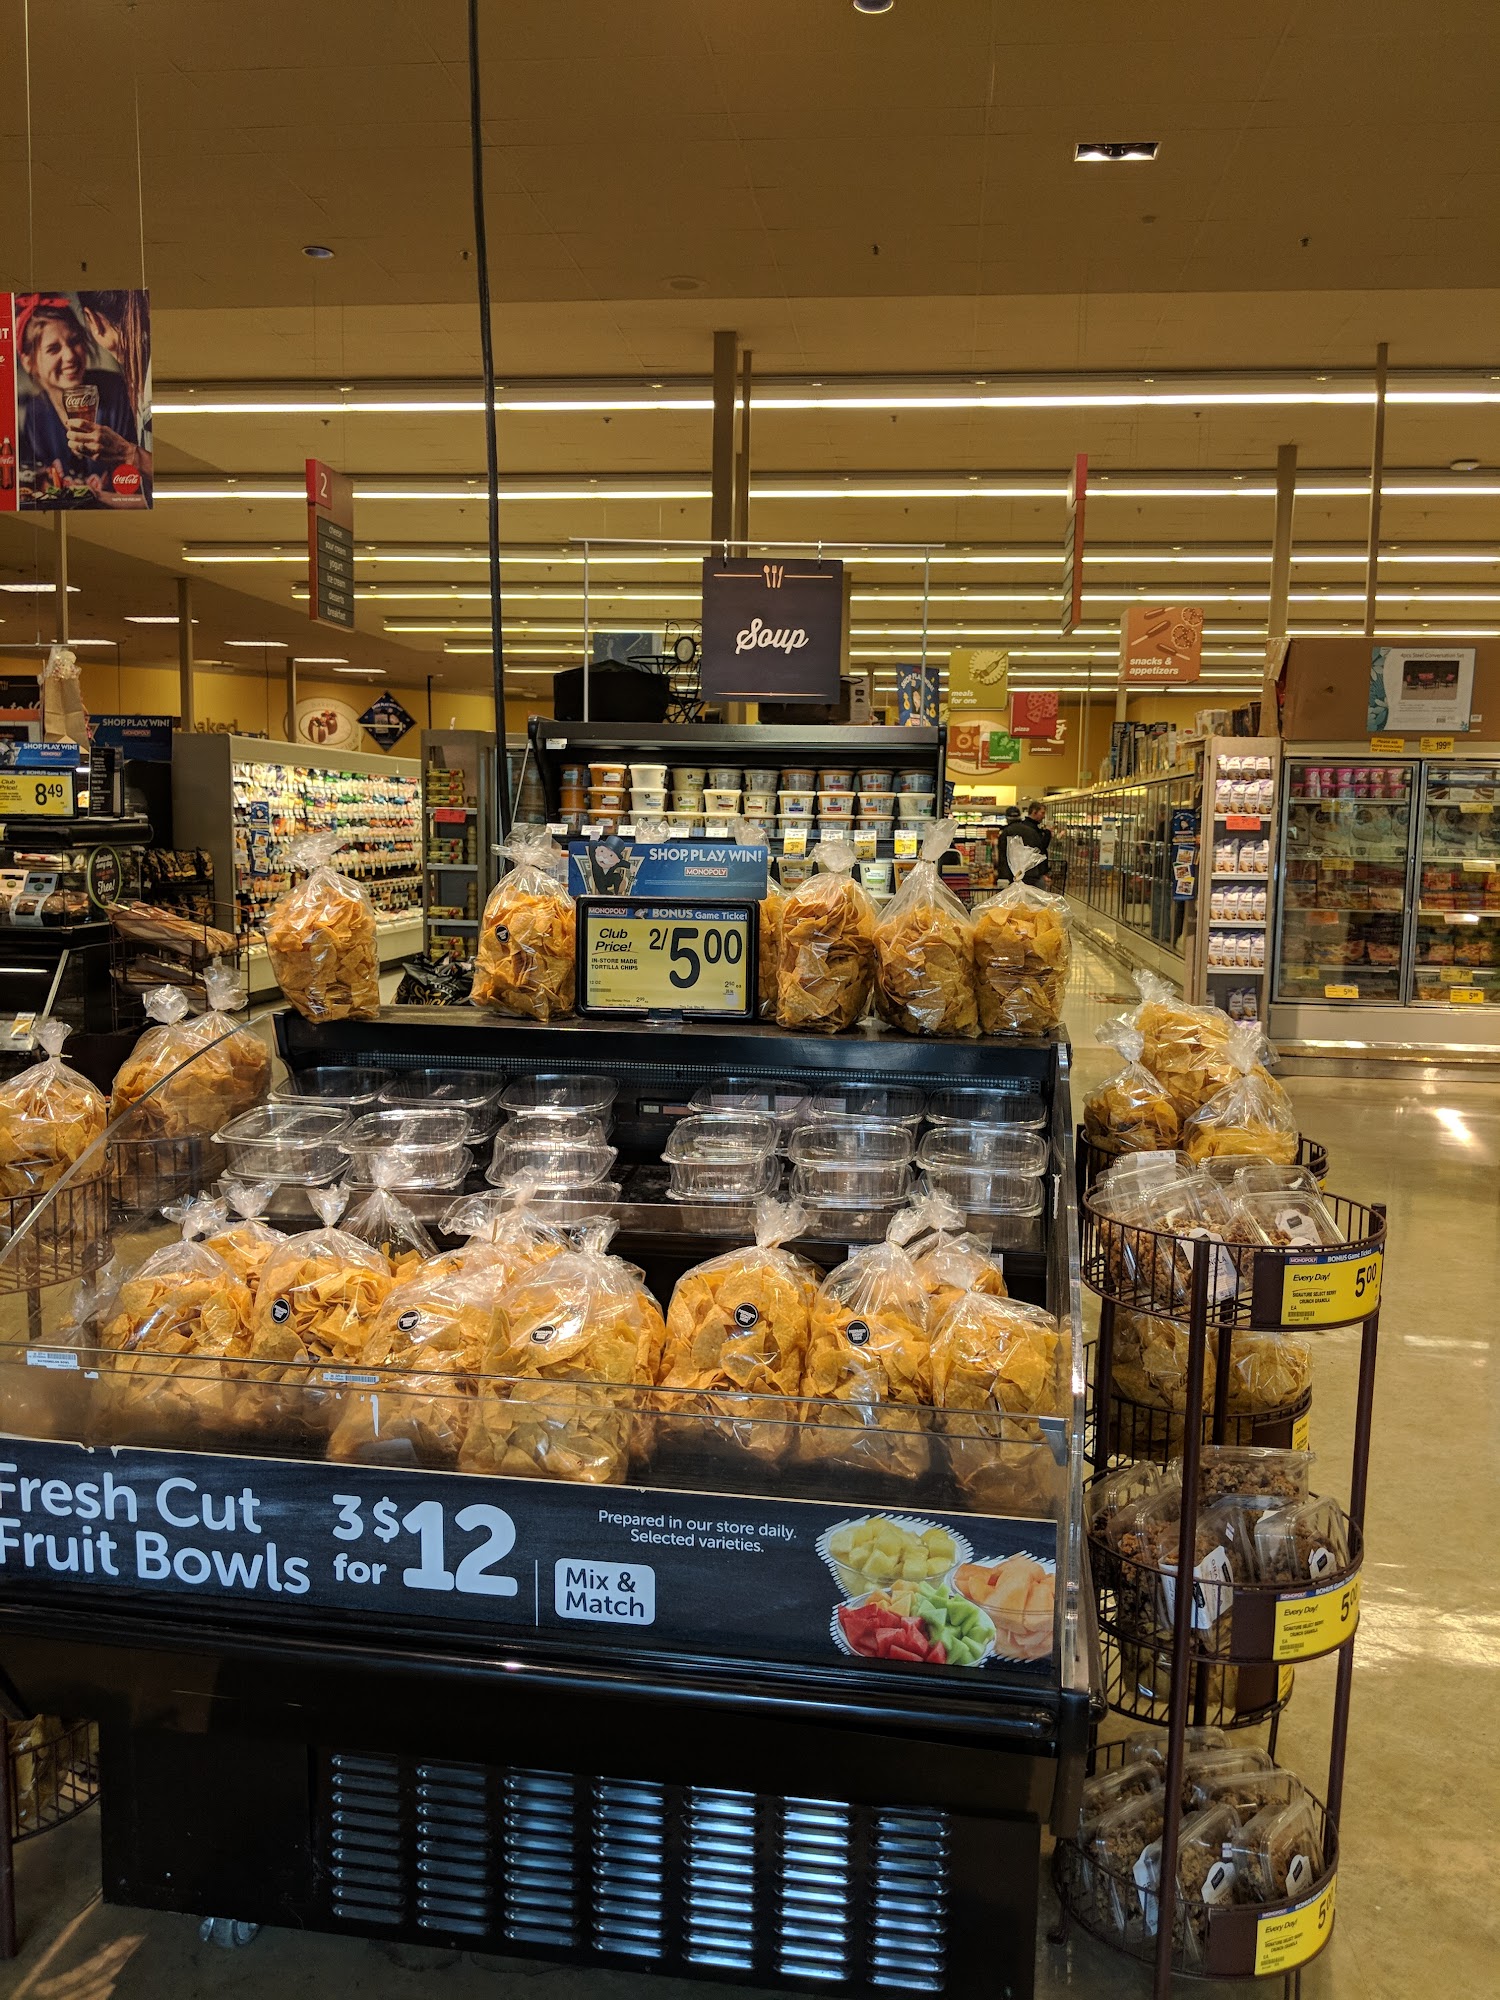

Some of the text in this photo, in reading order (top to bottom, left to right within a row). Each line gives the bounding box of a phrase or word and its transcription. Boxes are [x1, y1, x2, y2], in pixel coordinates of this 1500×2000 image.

[320, 472, 328, 498] 2
[328, 526, 342, 539] cheese
[325, 541, 346, 556] sour cream
[329, 559, 343, 572] yogurt
[334, 577, 346, 588] cream
[328, 592, 345, 605] desserts
[327, 606, 346, 620] breakfast
[735, 618, 809, 655] Soup
[1130, 657, 1172, 665] snacks &
[1129, 666, 1179, 676] appetizers
[150, 719, 170, 727] WIN!
[727, 849, 762, 863] WIN!
[684, 867, 728, 877] MONOPOLY
[588, 907, 628, 916] MONOPOLY
[652, 908, 748, 920] BONUS Game Ticket
[599, 928, 628, 939] Club
[595, 940, 632, 952] Price!
[1289, 1248, 1372, 1264] MONOPOLY BONUS Game Ticket
[1292, 1272, 1331, 1283] Every Day!
[0, 1462, 262, 1534] Fresh Cut
[332, 1493, 363, 1541] 3
[598, 1510, 798, 1541] Prepared in our store daily.
[630, 1529, 765, 1553] Selected varieties.
[0, 1517, 311, 1594] Fruit Bowls
[333, 1552, 387, 1584] for
[565, 1566, 636, 1593] Mix &
[1315, 1585, 1334, 1595] BONUS
[565, 1590, 645, 1618] Match
[1284, 1604, 1319, 1617] Every Day!
[1302, 1622, 1314, 1630] SELECT
[1265, 1918, 1298, 1933] Every Day!
